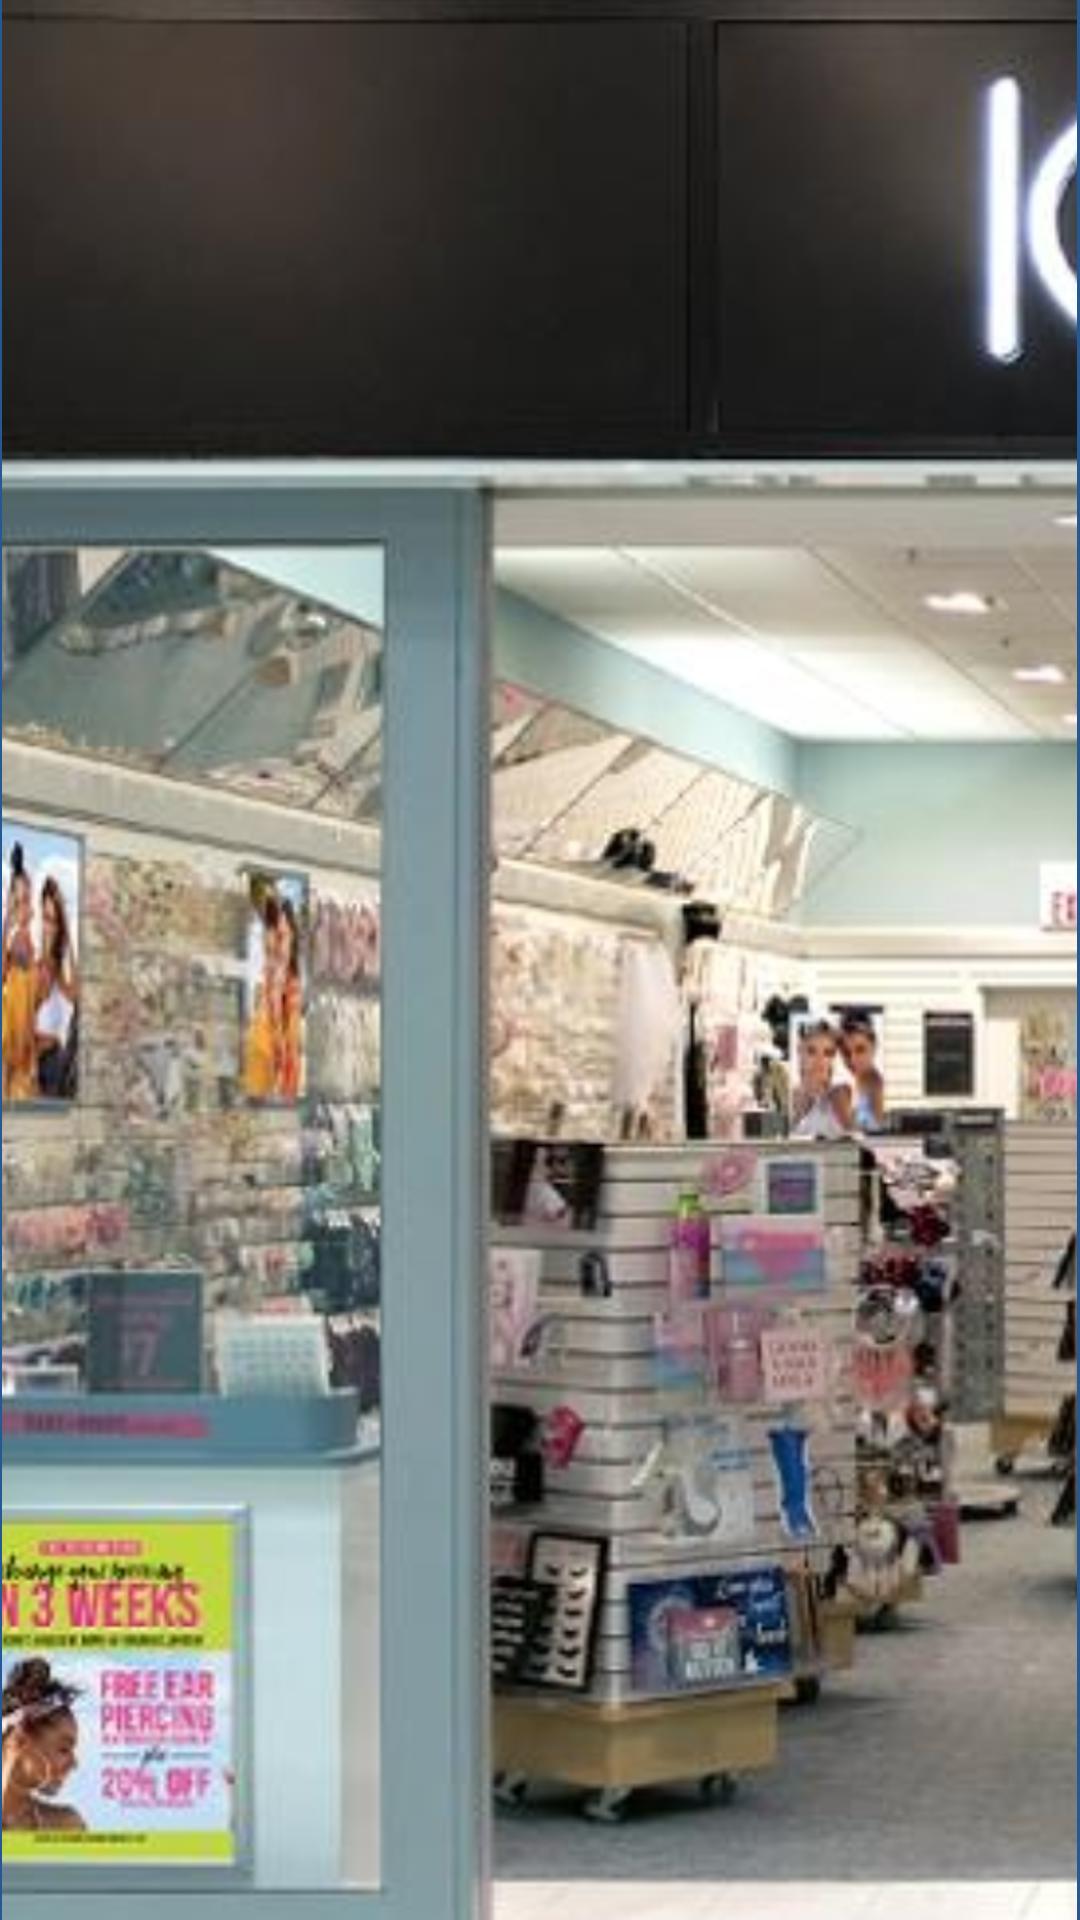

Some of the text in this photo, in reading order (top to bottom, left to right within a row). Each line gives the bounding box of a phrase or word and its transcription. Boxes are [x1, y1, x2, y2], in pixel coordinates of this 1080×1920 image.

[32, 1583, 55, 1628] 3
[68, 1583, 201, 1628] WEEKS
[101, 1670, 214, 1699] FREE EAR
[101, 1705, 214, 1732] PIERCING
[101, 1768, 211, 1799] 20% OFF
